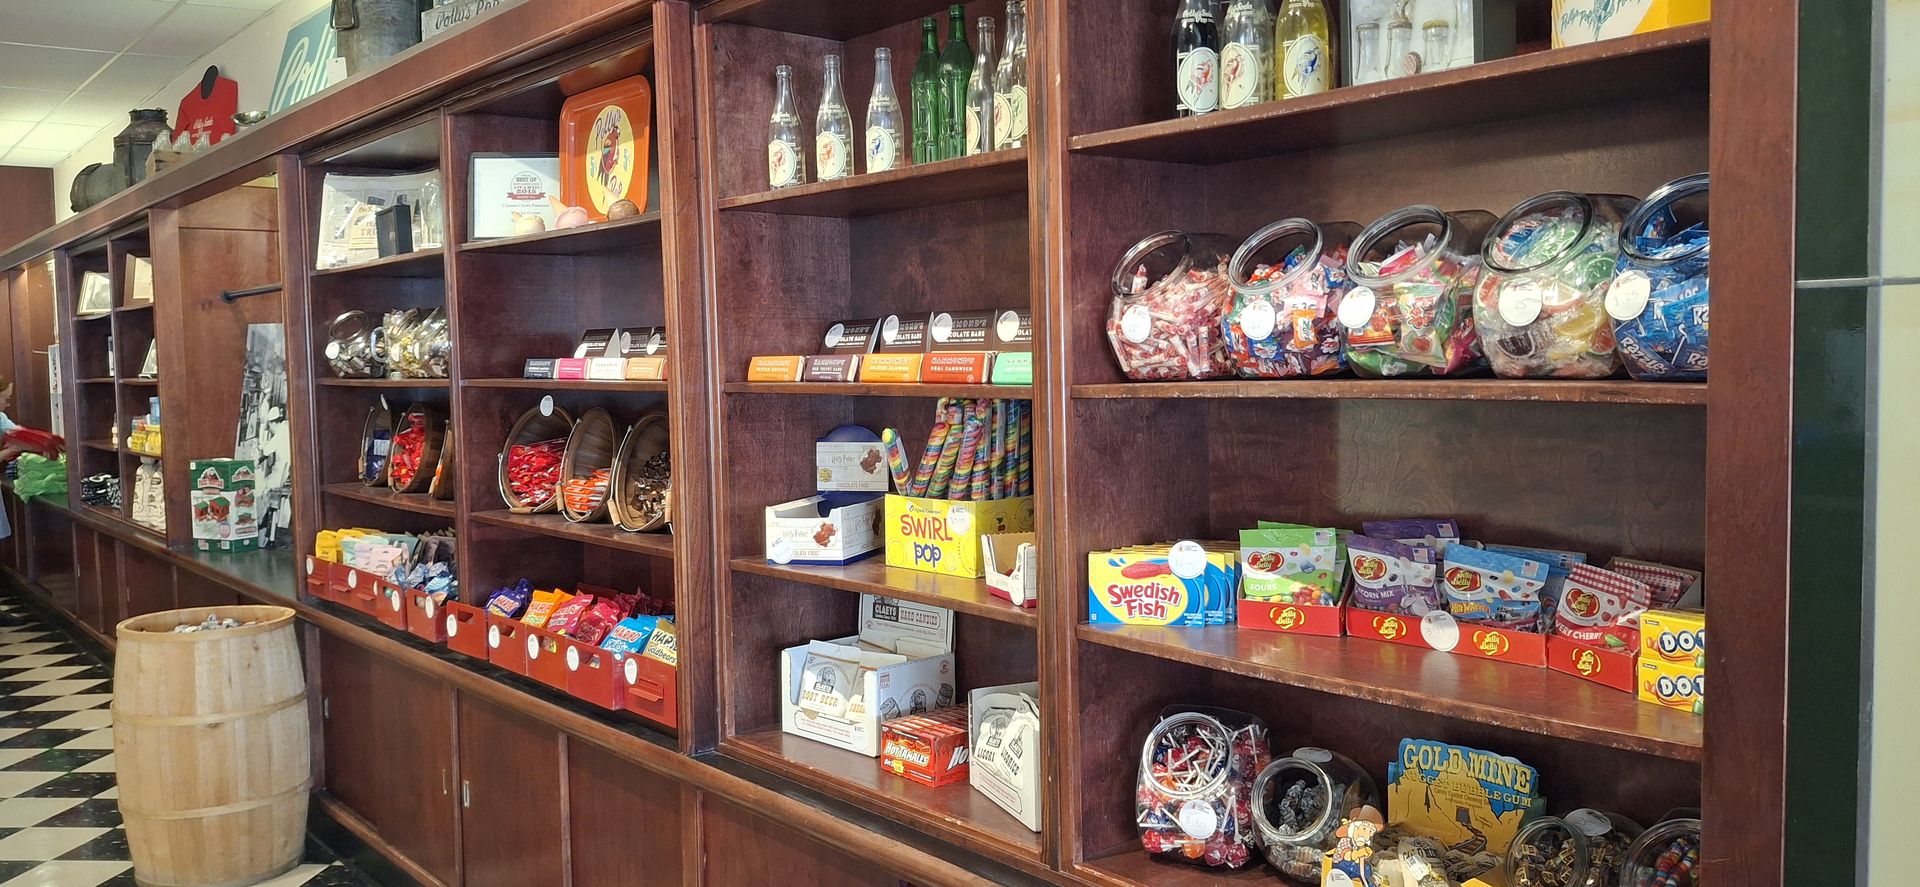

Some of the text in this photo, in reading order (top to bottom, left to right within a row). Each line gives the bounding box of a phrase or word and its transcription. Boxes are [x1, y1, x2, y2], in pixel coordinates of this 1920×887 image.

[271, 23, 337, 114] Poll
[1620, 336, 1670, 375] Razzles
[1107, 582, 1182, 607] Swedish
[874, 605, 897, 617] CLAEYS
[1124, 598, 1168, 620] Fish
[1275, 615, 1294, 627] Belly
[1555, 619, 1602, 641] VERY CHERRY
[1480, 641, 1498, 652] Belly
[1661, 630, 1704, 652] DOT
[1659, 675, 1704, 697] DOT
[947, 744, 968, 771] HO
[1403, 744, 1532, 795] GOLD MINE
[1503, 793, 1532, 808] GUM
